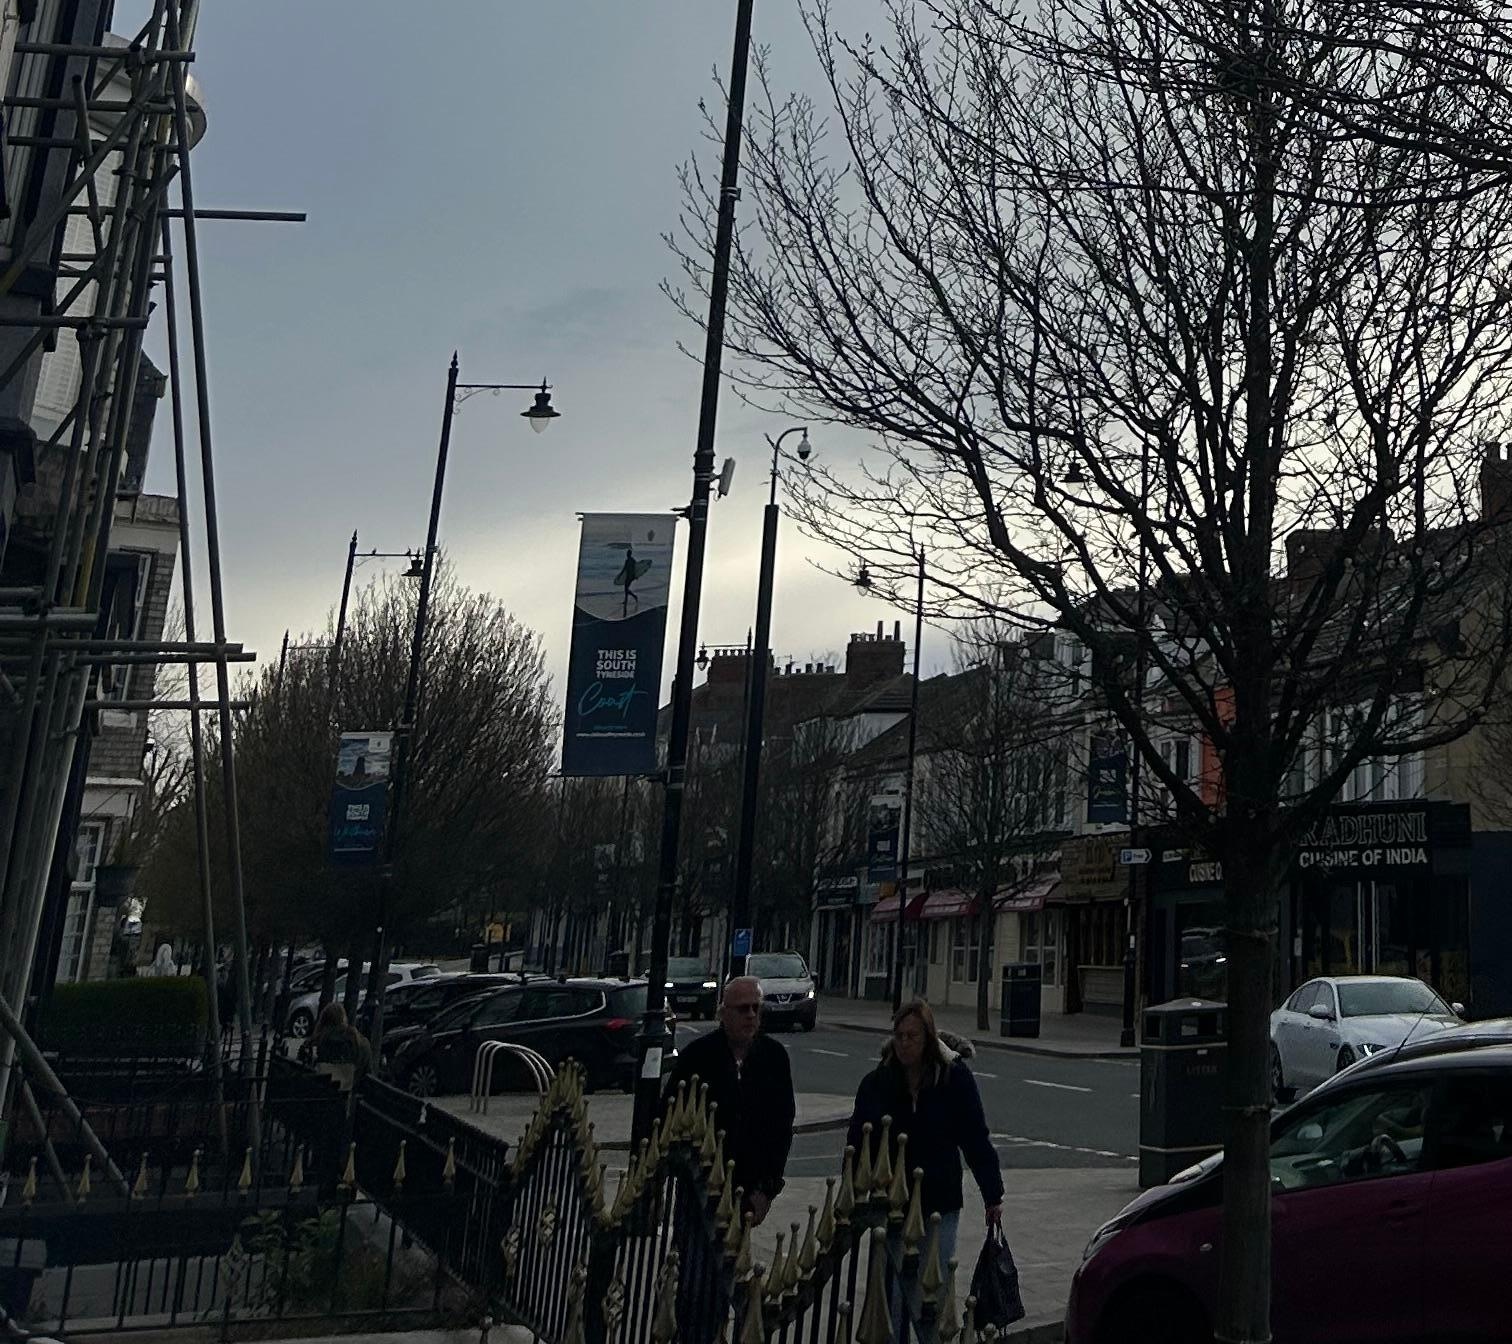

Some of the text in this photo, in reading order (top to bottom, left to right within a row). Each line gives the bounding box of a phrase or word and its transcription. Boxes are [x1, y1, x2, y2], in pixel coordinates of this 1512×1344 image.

[597, 649, 637, 661] THIS IS
[596, 660, 636, 671] SOUTH
[1300, 847, 1428, 868] CUISINE OF INDIA
